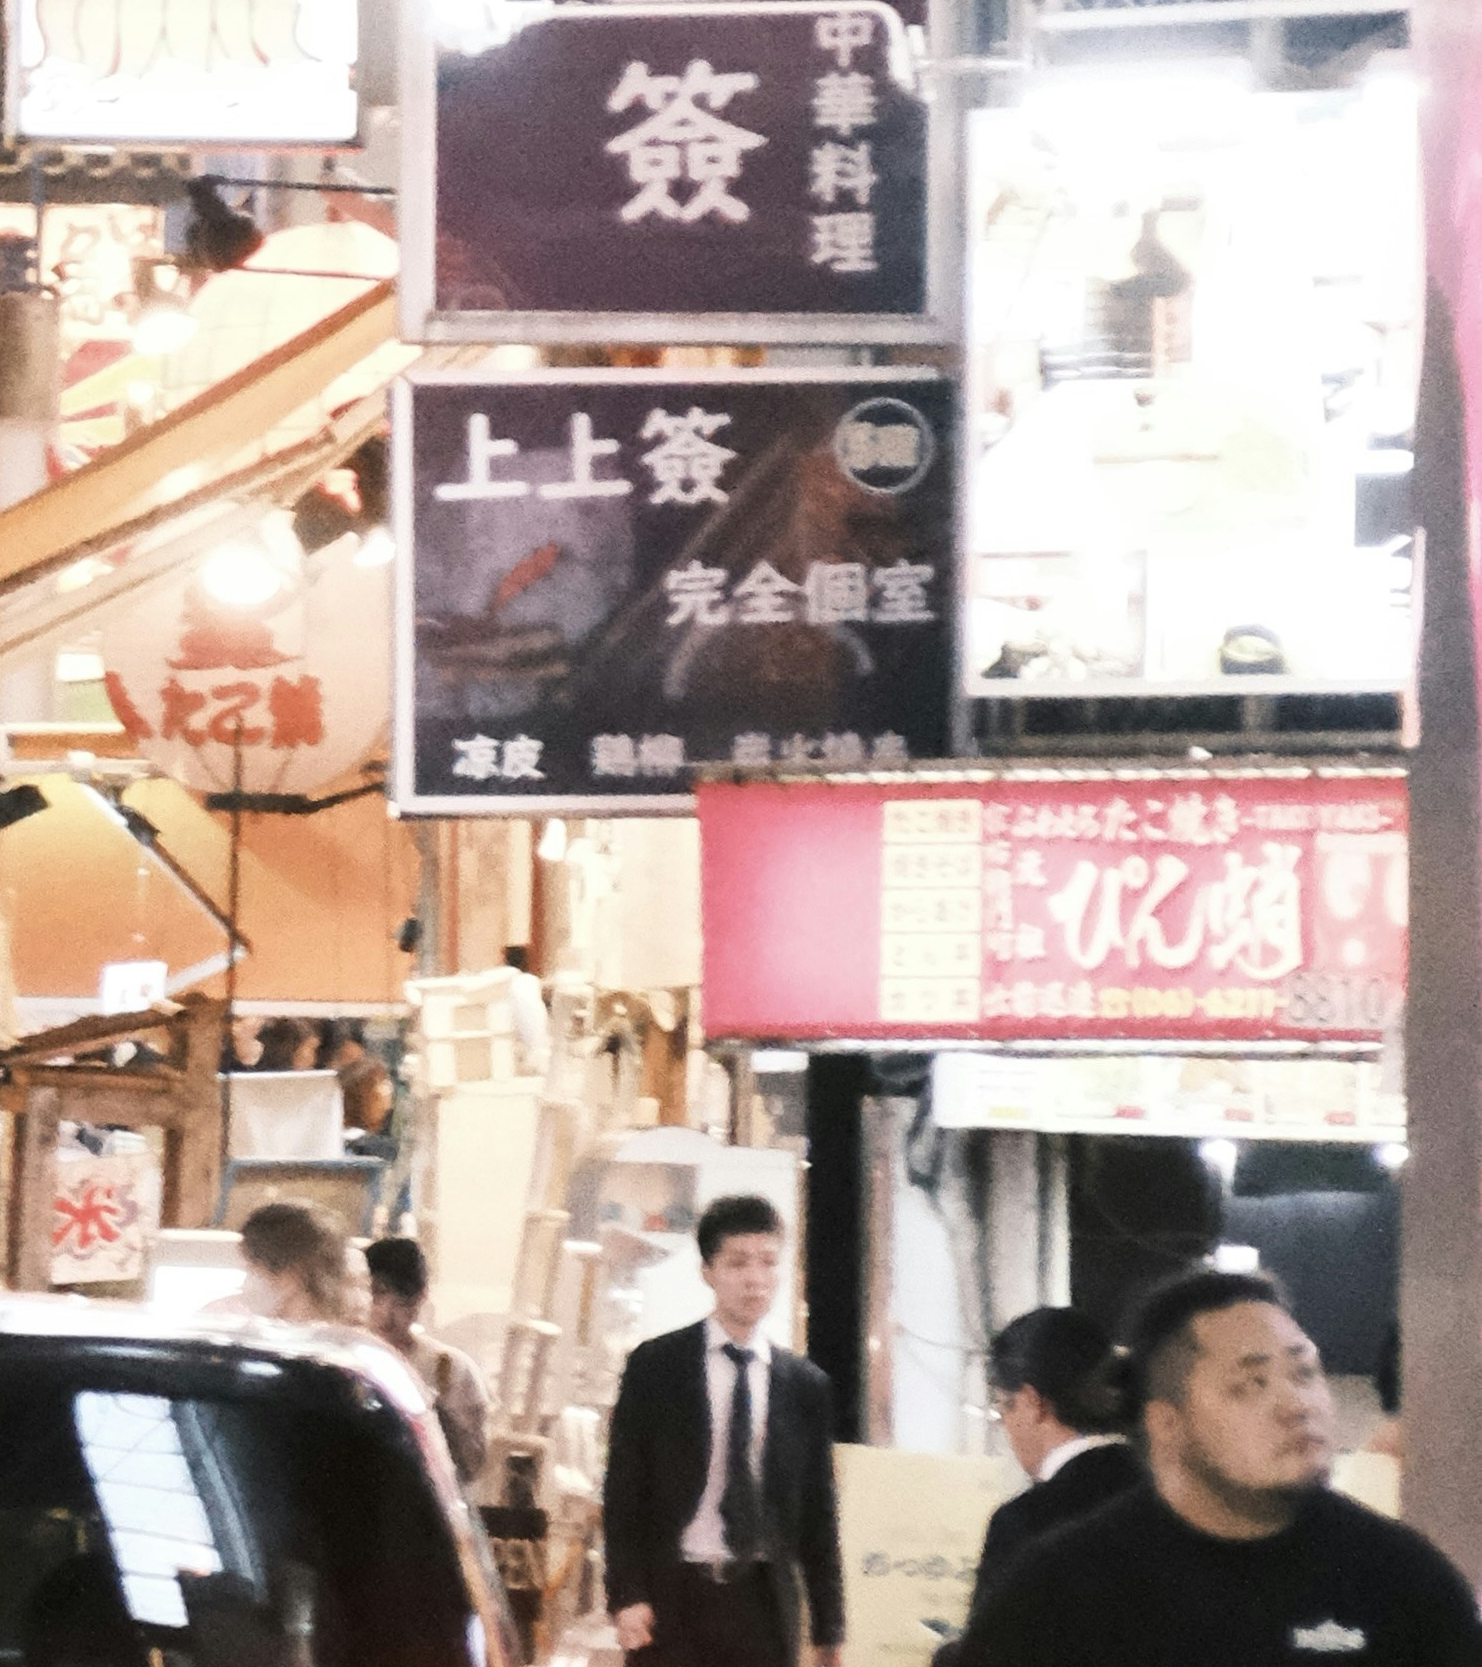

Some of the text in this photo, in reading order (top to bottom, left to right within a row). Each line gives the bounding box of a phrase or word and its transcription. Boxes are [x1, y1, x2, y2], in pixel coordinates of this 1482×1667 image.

[808, 12, 879, 274] 中華料理
[663, 559, 936, 627] 完全個室
